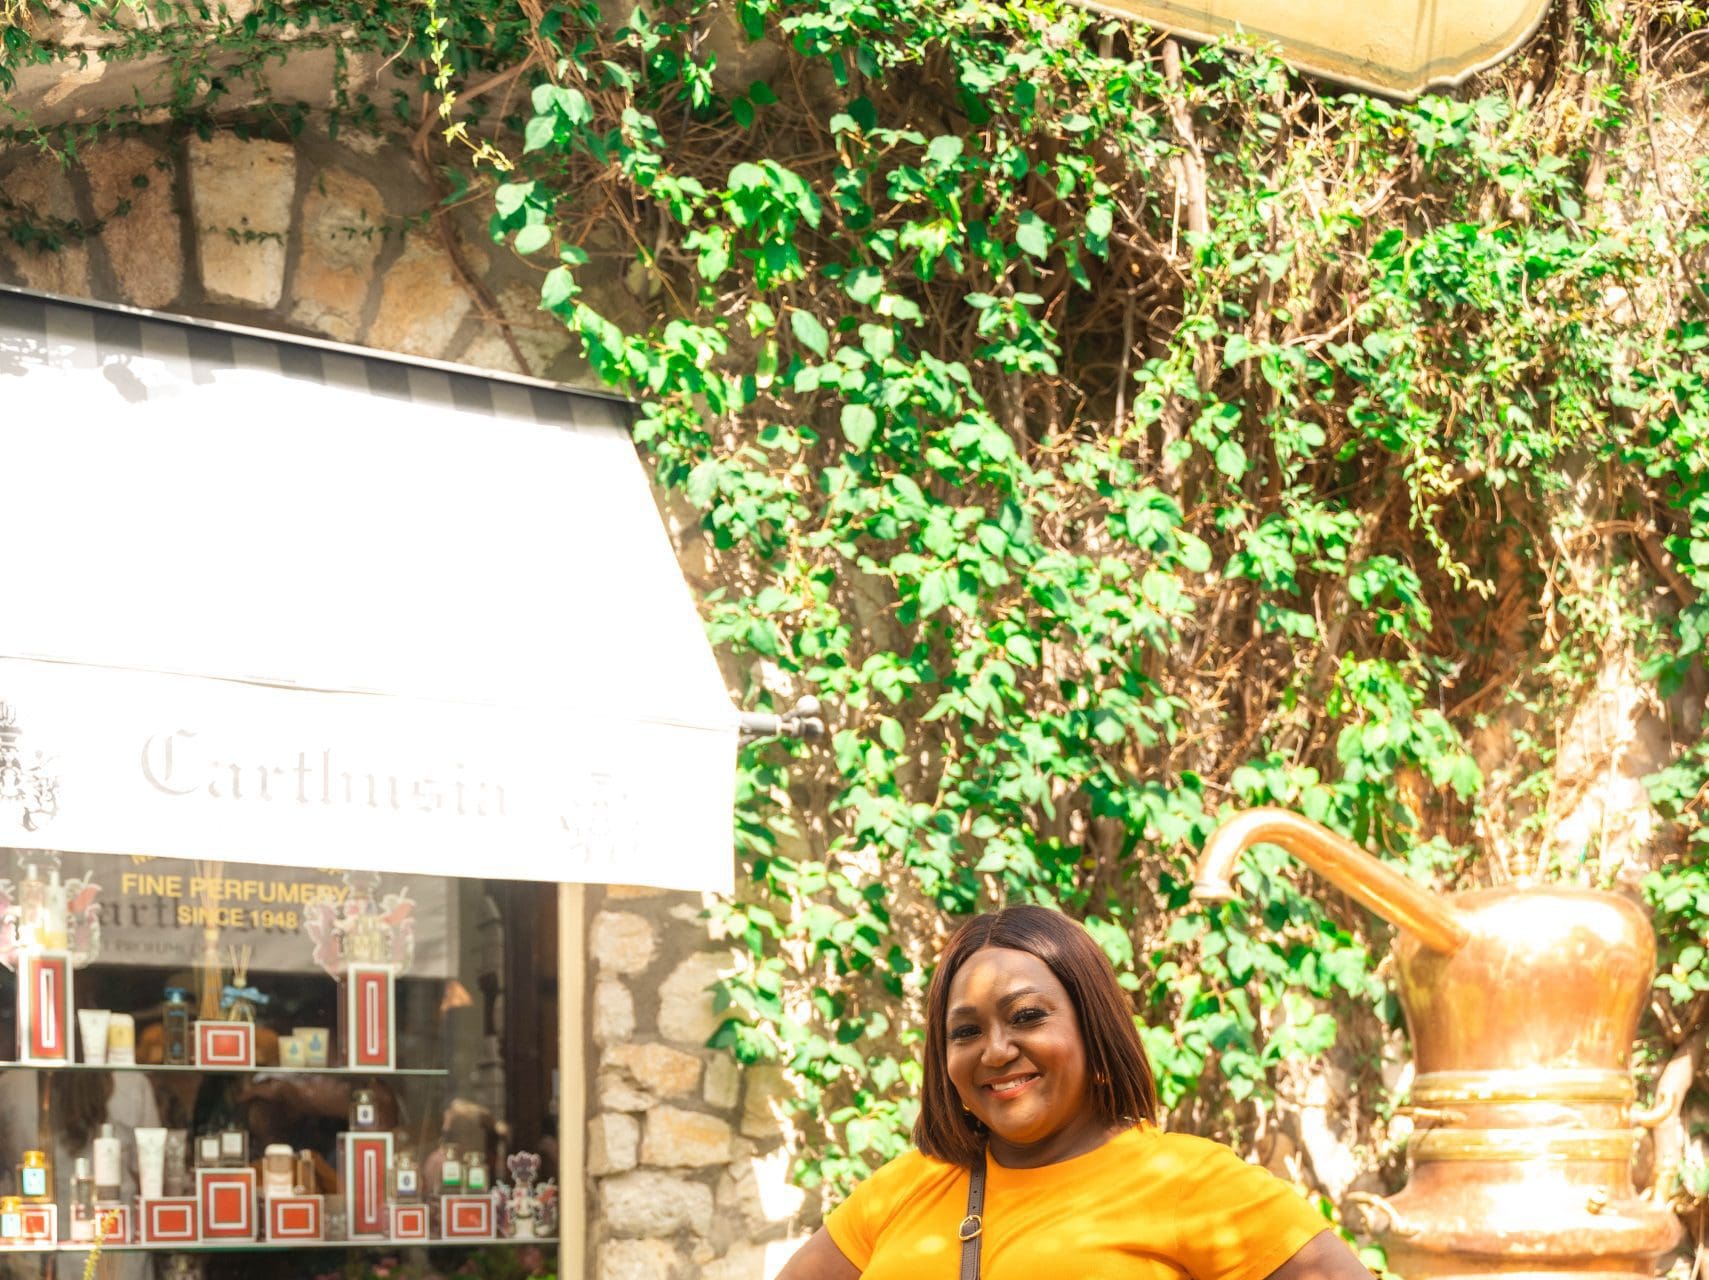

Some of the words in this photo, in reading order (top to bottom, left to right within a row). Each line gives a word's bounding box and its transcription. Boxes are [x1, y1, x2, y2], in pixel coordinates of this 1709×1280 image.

[121, 873, 182, 898] FINE
[190, 878, 350, 906] PERFUMERY
[177, 905, 245, 928] SINCE
[251, 910, 299, 929] 1948
